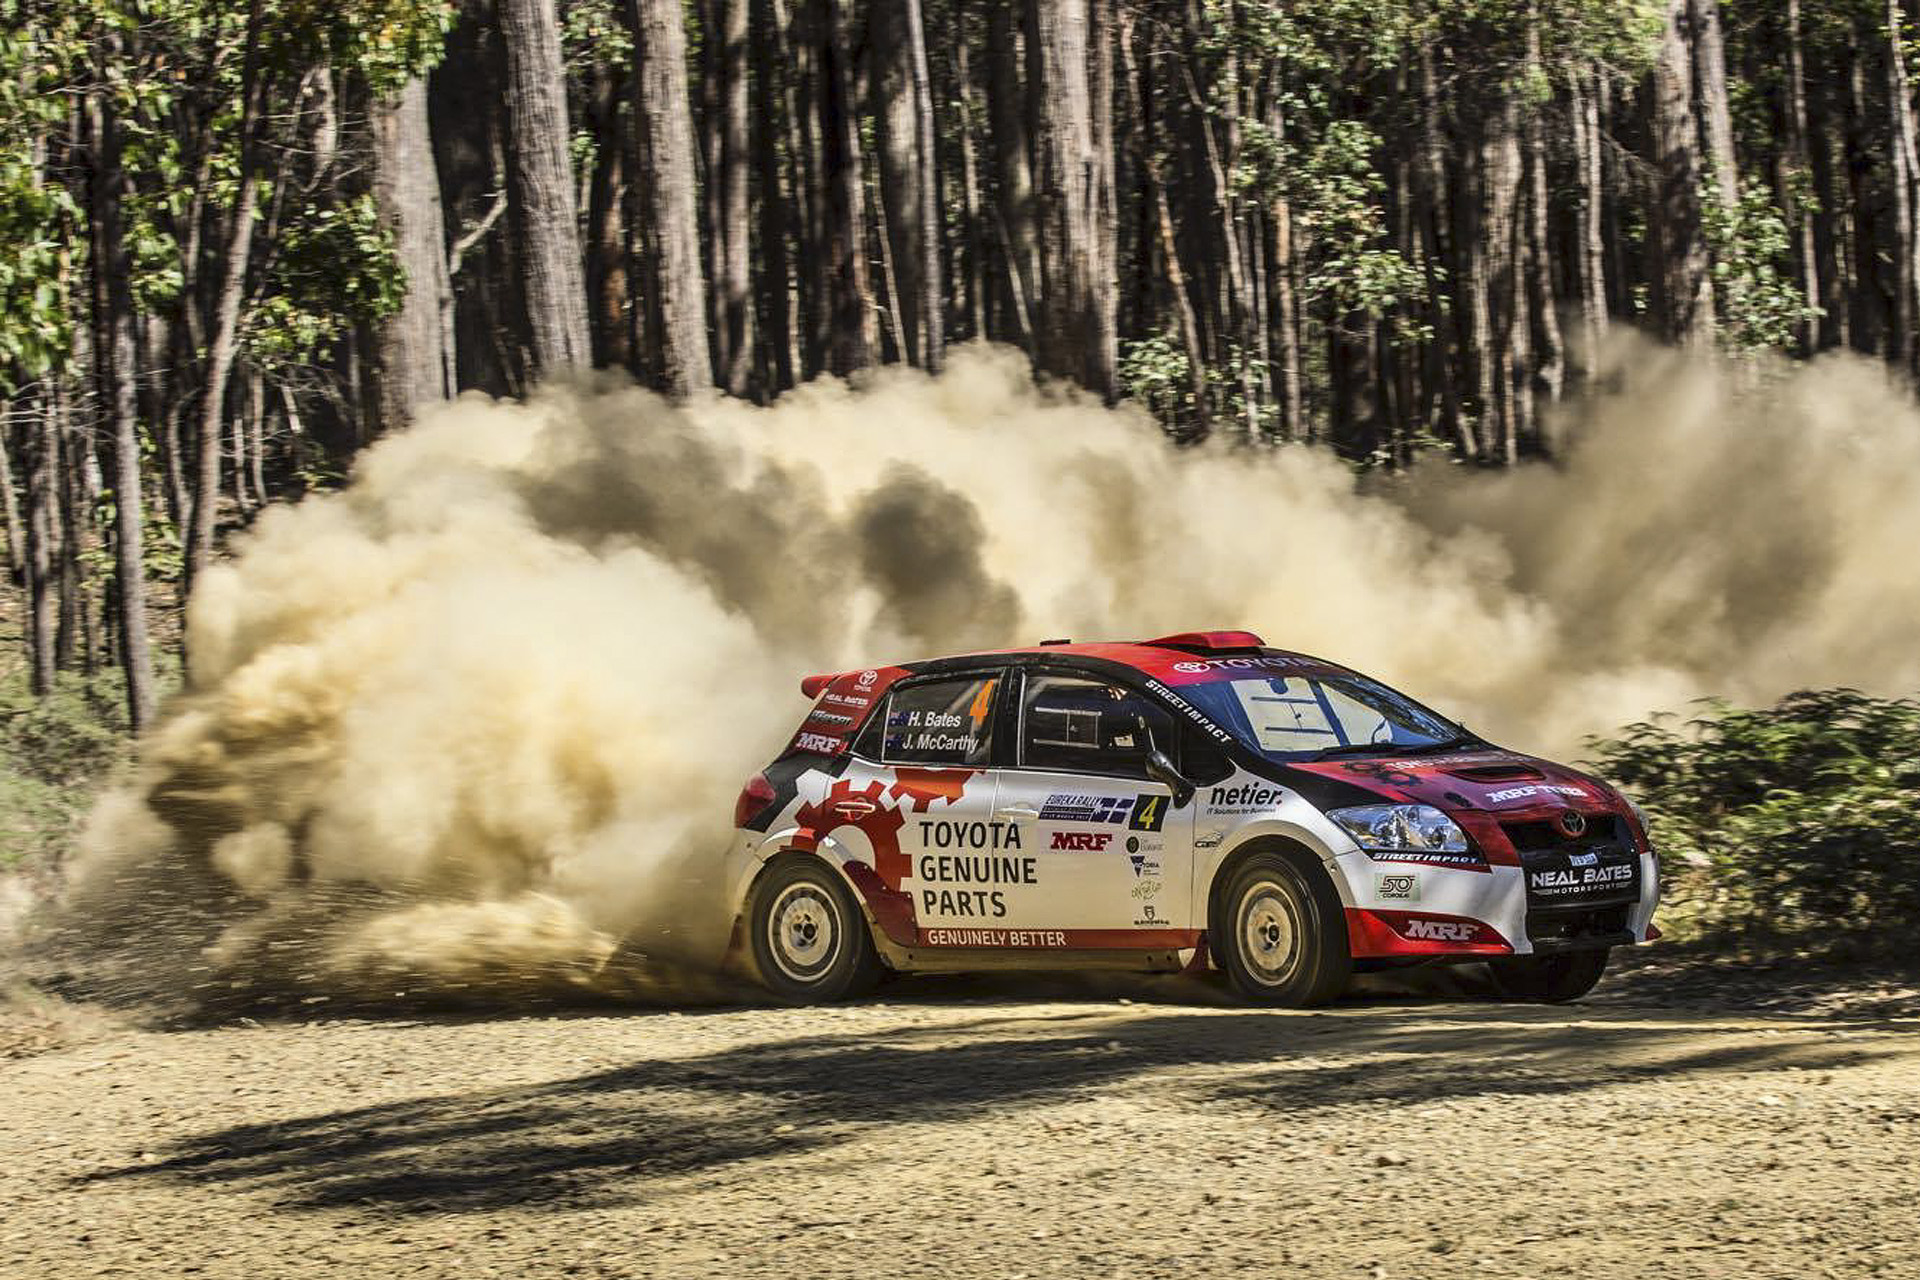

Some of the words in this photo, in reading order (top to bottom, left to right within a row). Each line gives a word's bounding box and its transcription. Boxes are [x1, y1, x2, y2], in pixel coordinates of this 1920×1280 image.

[1205, 658, 1320, 669] TOYOTA
[969, 679, 995, 727] 4
[907, 711, 921, 727] H.
[924, 711, 962, 727] Bates
[796, 732, 841, 753] MRF
[902, 733, 913, 749] J.
[916, 733, 980, 754] McCarthy
[1485, 785, 1538, 802] MRF
[1138, 796, 1159, 829] 4
[919, 821, 1021, 849] TOYOTA
[1050, 832, 1113, 852] MRF
[920, 855, 1038, 884] GENUINE
[1531, 870, 1580, 887] NEAL
[1583, 864, 1633, 883] BATES
[923, 889, 1007, 917] PARTS
[927, 929, 1006, 945] GENUINELY
[1010, 931, 1067, 946] BETTER
[1405, 920, 1480, 941] MRF
